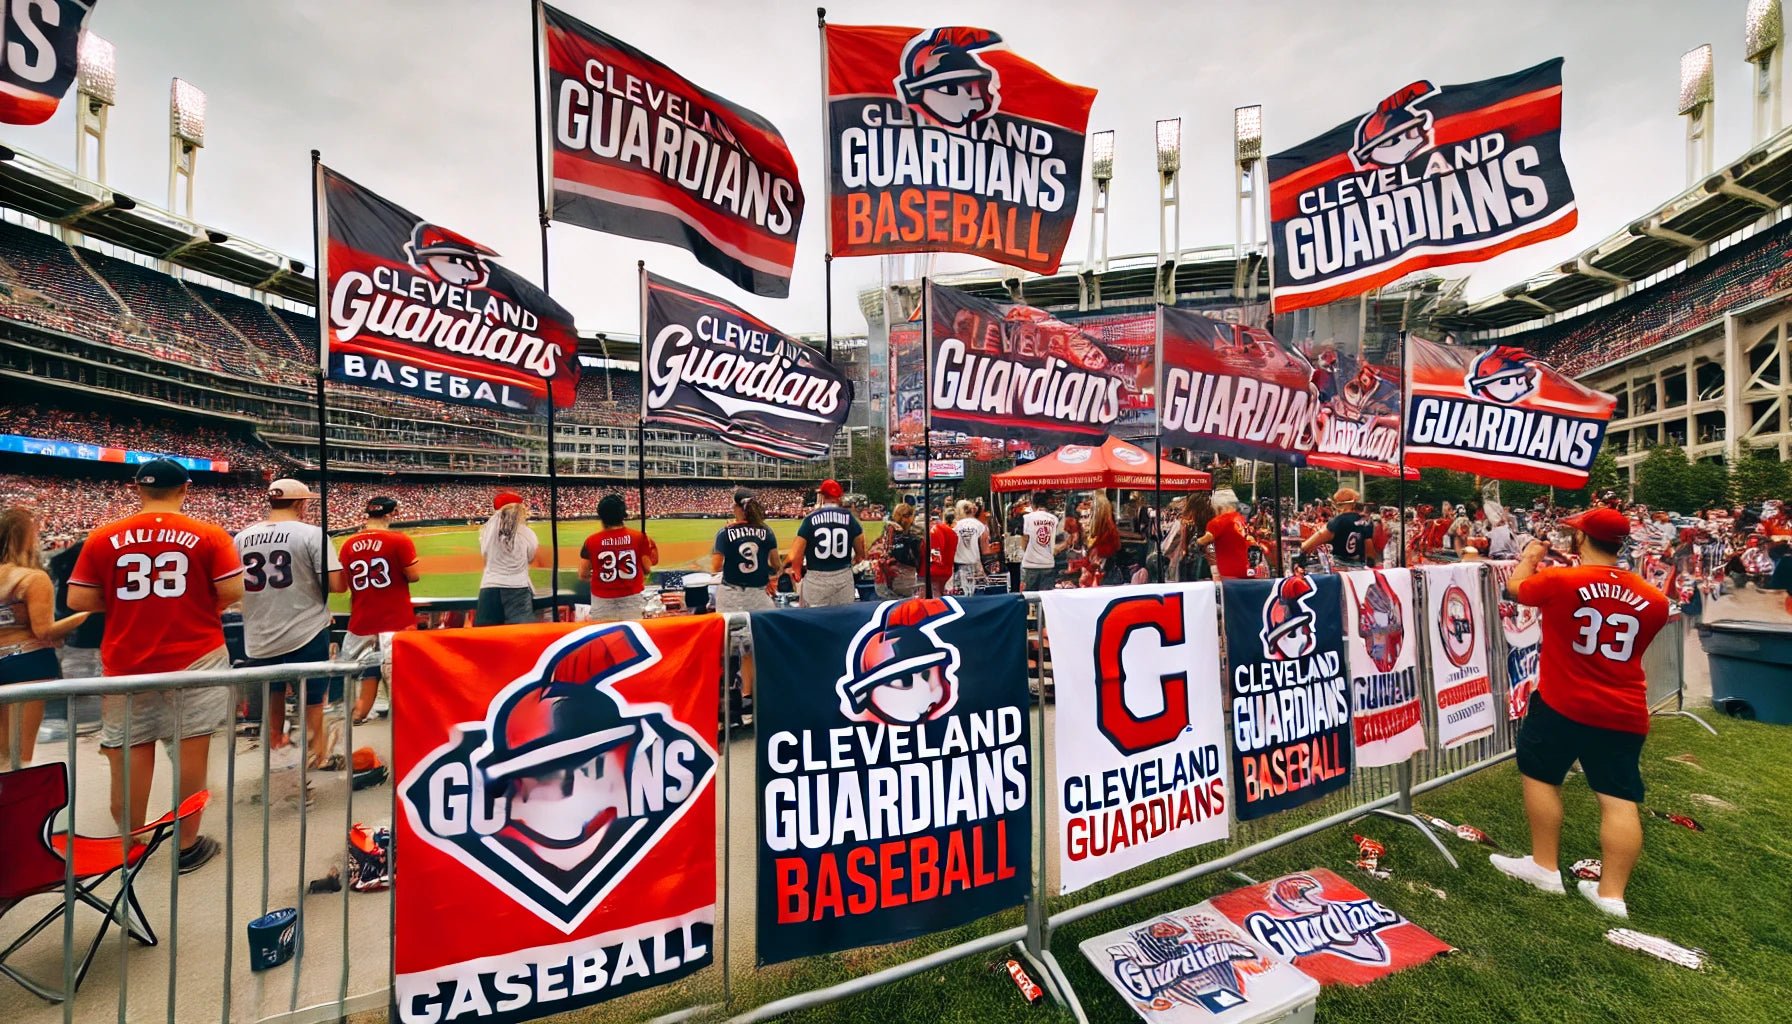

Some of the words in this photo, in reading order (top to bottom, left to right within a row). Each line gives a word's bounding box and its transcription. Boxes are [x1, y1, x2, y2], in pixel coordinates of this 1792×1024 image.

[0, 0, 60, 83] S
[585, 59, 750, 158] CLEVEL
[557, 79, 794, 235] GUARDIANS
[841, 127, 1067, 212] GUARDIANS
[1299, 132, 1505, 215] CLEVELAND
[847, 188, 1049, 262] BASEBALL
[1285, 145, 1549, 280] GUARDIANS
[330, 271, 562, 377] Guardians
[373, 266, 538, 332] CLEVELAND
[648, 324, 841, 415] Guardians
[933, 338, 1122, 424] Guardians
[1412, 398, 1598, 467] GUARDIANS
[814, 527, 848, 559] 30
[1094, 592, 1189, 756] C
[1235, 651, 1339, 693] CLEVELAND
[1573, 607, 1640, 662] 33
[768, 705, 1022, 772] CLEVELAND
[1233, 677, 1348, 752] GUARDIANS
[765, 745, 1027, 852] GUARDIANS
[1064, 744, 1219, 814] CLEVELAND
[1243, 733, 1345, 803] BASEBALL
[1067, 777, 1225, 862] GUARDIANS
[775, 820, 1016, 925] BASEBALL
